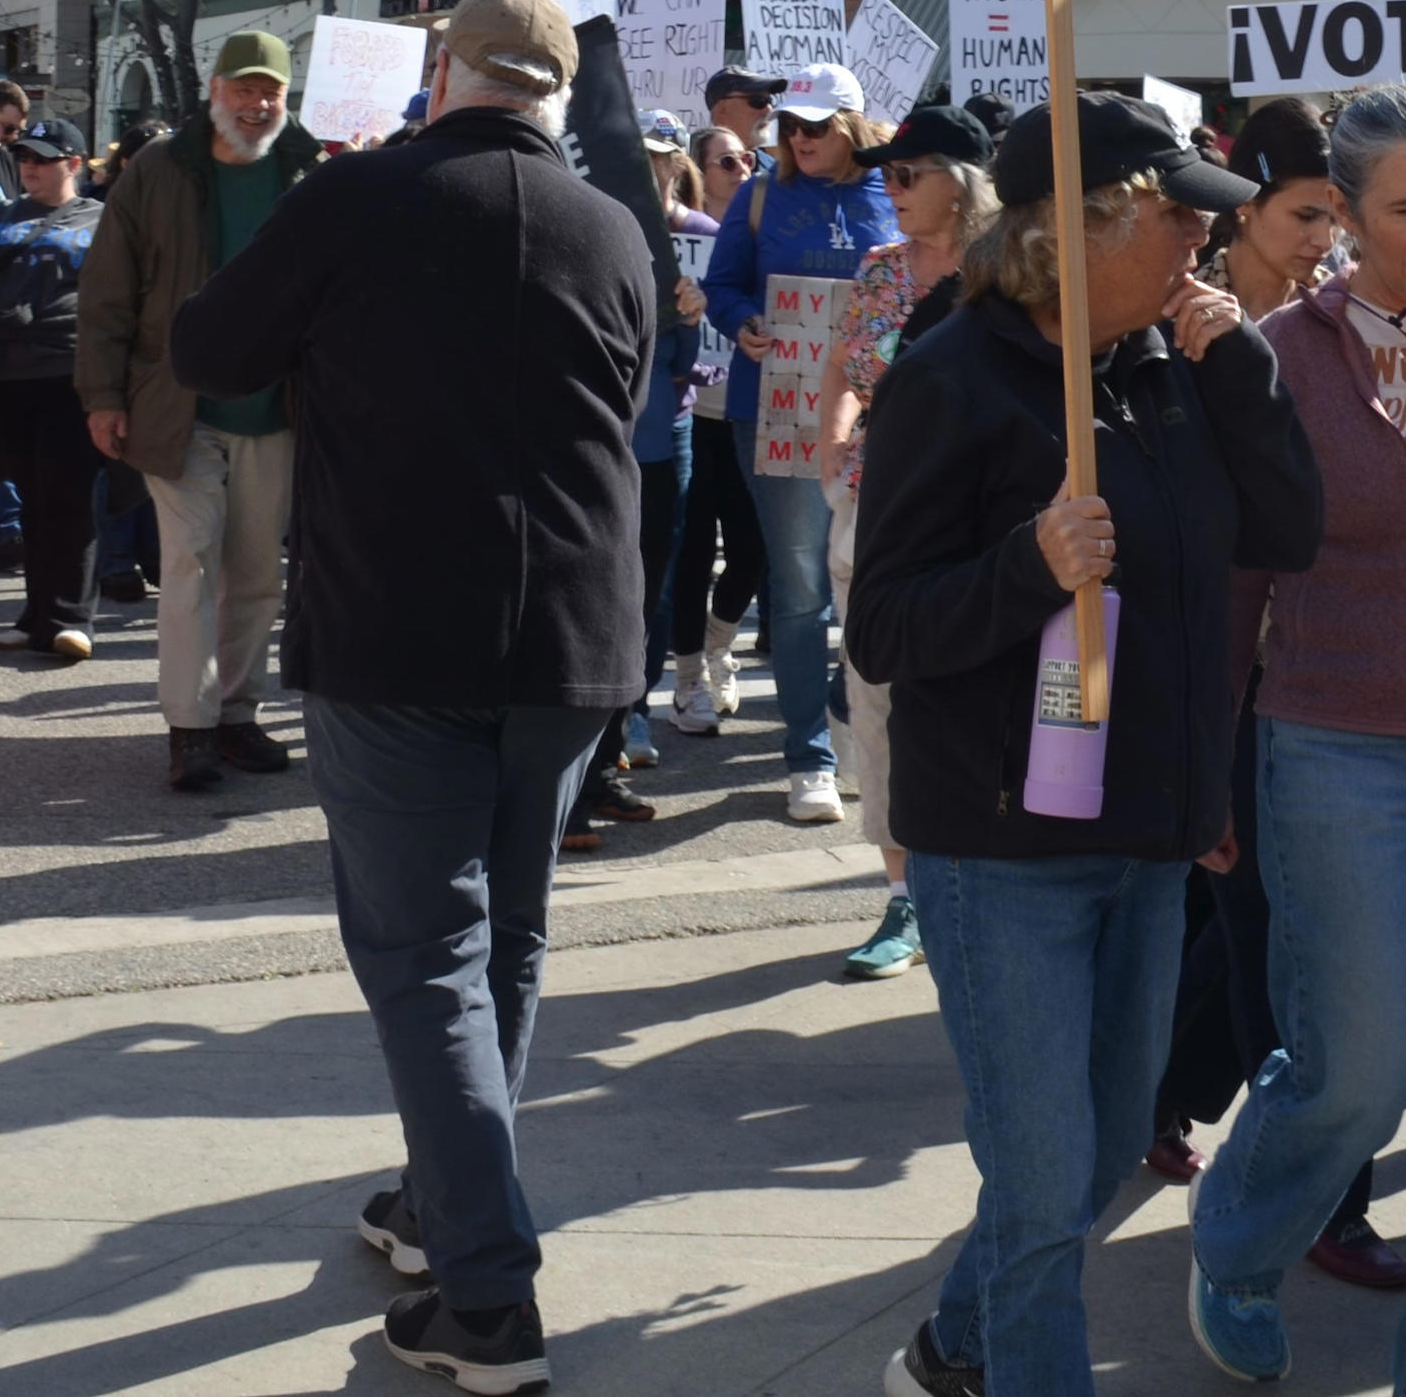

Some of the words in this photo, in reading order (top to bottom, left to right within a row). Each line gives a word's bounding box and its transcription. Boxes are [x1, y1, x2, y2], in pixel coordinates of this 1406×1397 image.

[760, 5, 842, 32] DECISION
[617, 27, 653, 59] SEE
[665, 20, 724, 56] RIGHT
[748, 31, 762, 60] A
[768, 33, 842, 64] WOMAN
[963, 37, 1045, 69] HUMAN
[777, 292, 825, 314] MY
[776, 340, 823, 361] MY
[772, 390, 819, 412] MY
[769, 441, 815, 462] MY
